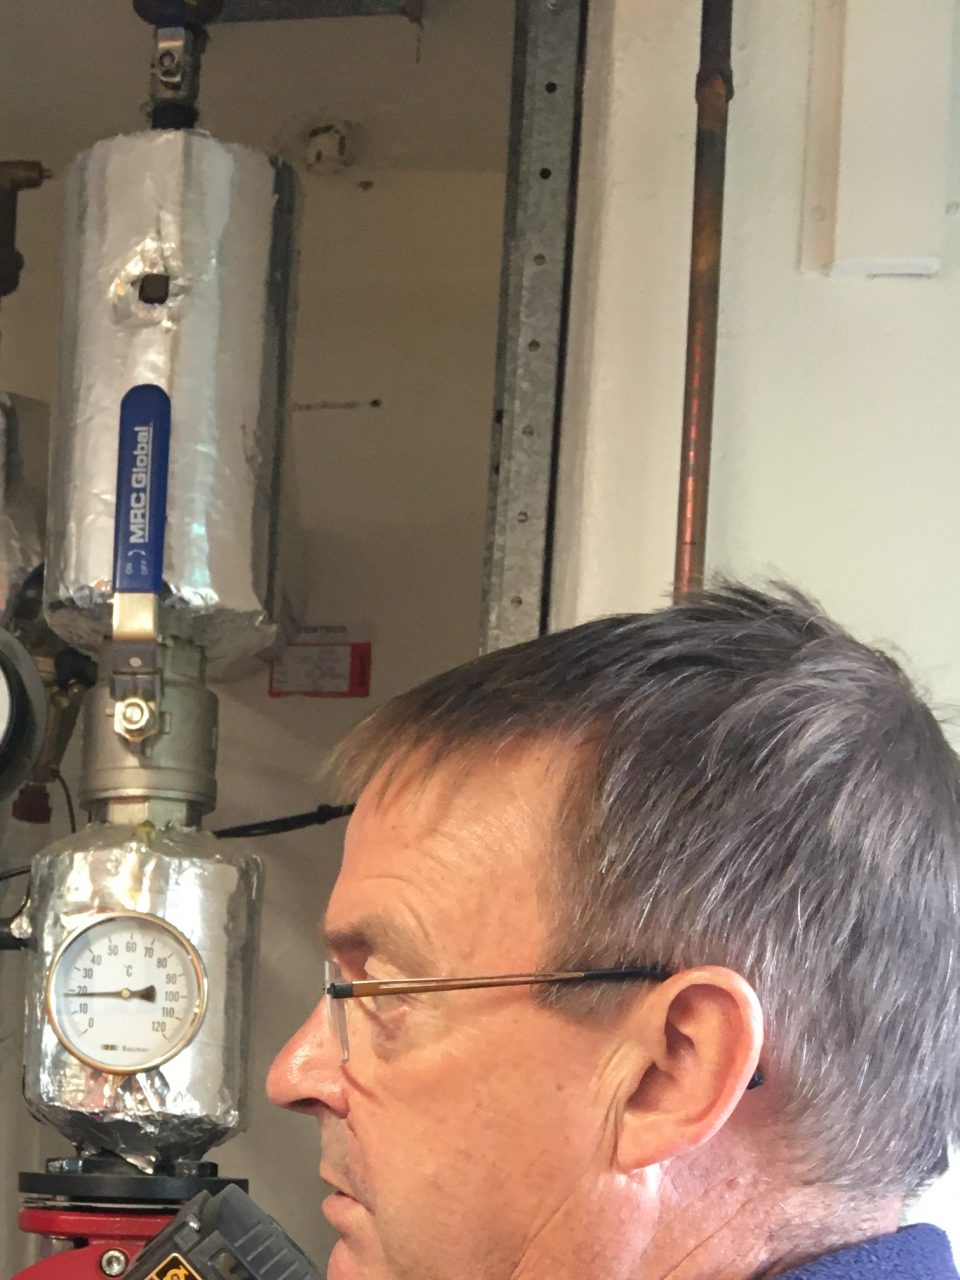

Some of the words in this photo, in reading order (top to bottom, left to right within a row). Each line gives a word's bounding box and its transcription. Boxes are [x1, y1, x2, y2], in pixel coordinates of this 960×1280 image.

[131, 426, 149, 488] Global
[129, 493, 146, 544] MRC
[107, 945, 119, 956] 50
[125, 941, 137, 953] 60
[143, 947, 154, 958] 70
[90, 954, 102, 965] 40
[156, 957, 168, 969] 80
[82, 968, 94, 979] 30
[165, 973, 177, 985] 90
[77, 985, 88, 996] 20
[164, 990, 180, 1002] 100
[78, 1003, 88, 1014] 10
[162, 1006, 175, 1018] 110
[88, 1017, 94, 1029] 0
[151, 1021, 167, 1032] 120
